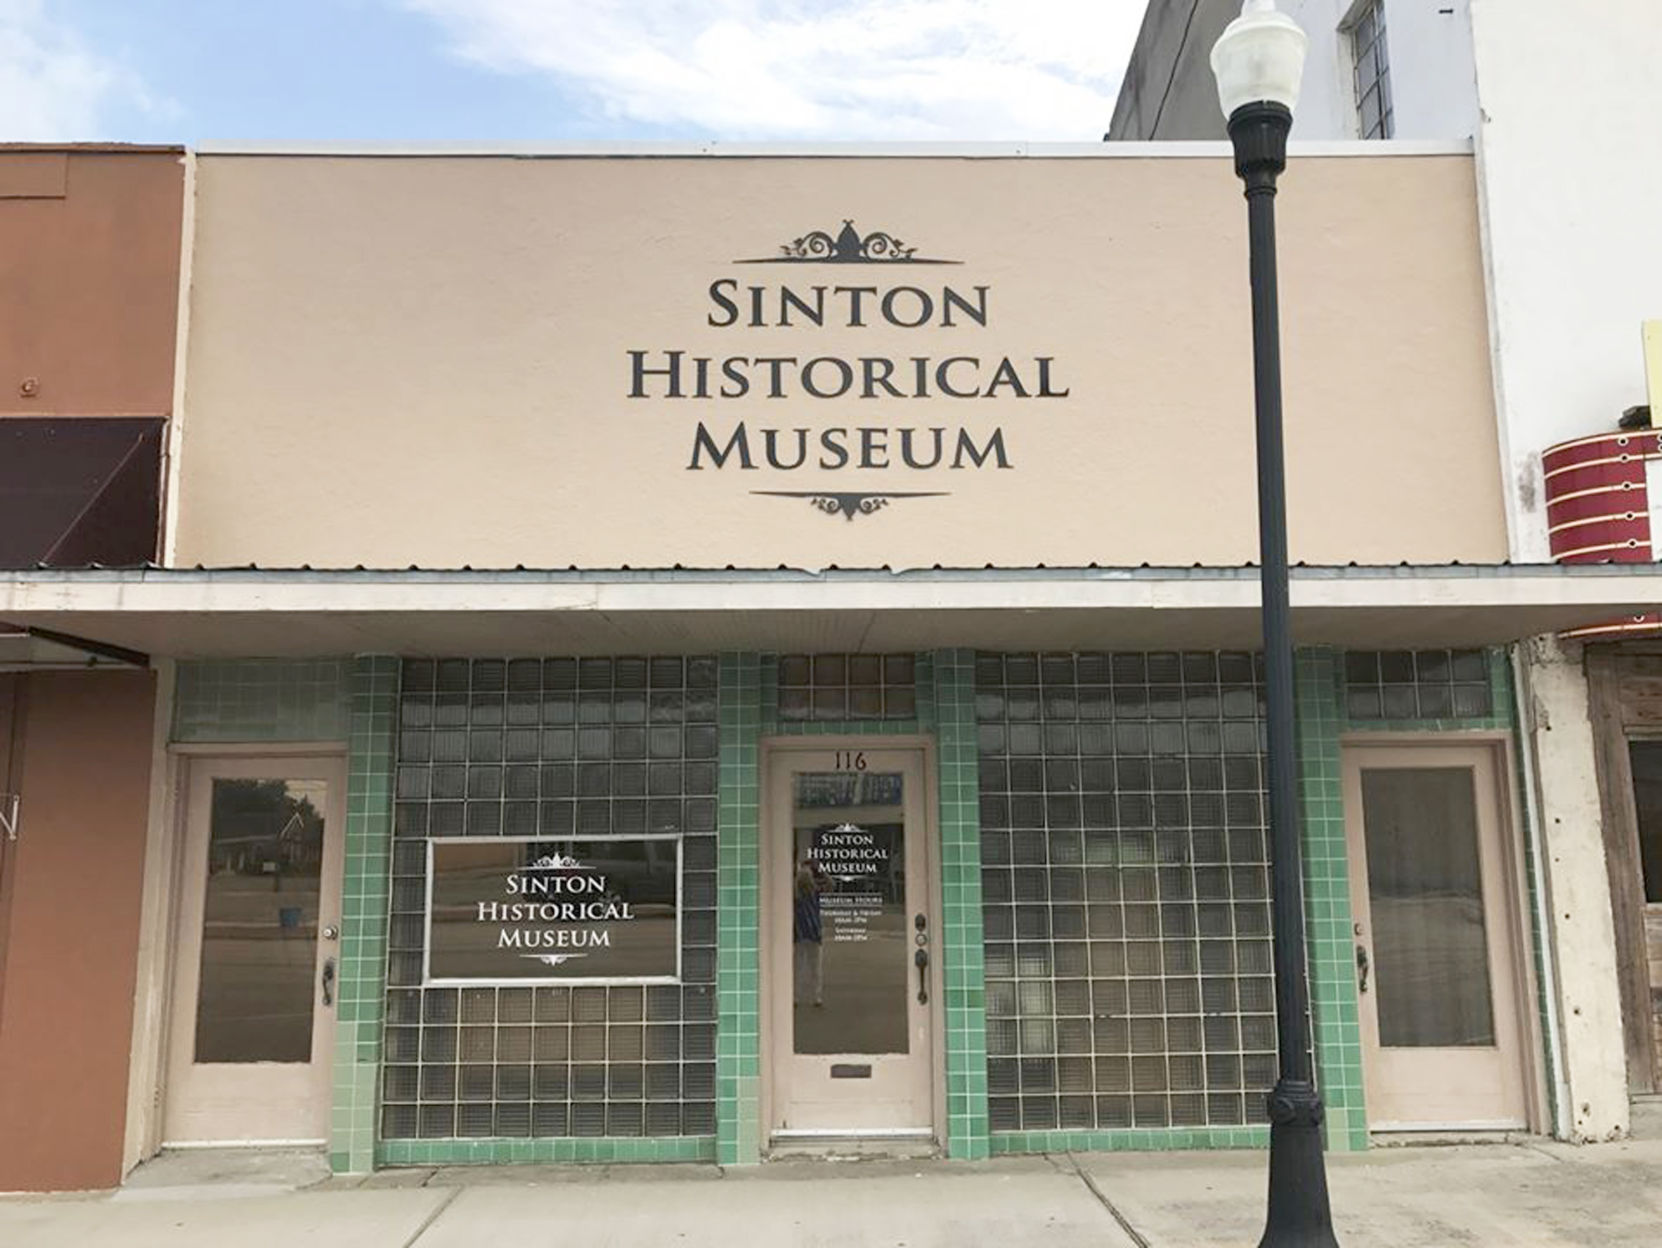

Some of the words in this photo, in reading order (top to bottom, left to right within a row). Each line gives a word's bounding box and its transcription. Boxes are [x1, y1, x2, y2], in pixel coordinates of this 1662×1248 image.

[707, 277, 990, 328] SINTON
[626, 350, 1070, 399] HISTORICAL
[686, 421, 1013, 471] MUSEUM
[836, 751, 867, 771] 116
[821, 833, 874, 845] SINTON
[807, 847, 888, 859] HISTORICAL
[818, 862, 877, 873] MUSEUM
[506, 874, 606, 894] SINTON
[477, 901, 635, 921] HISTORICAL
[498, 928, 611, 948] MUSEUM
